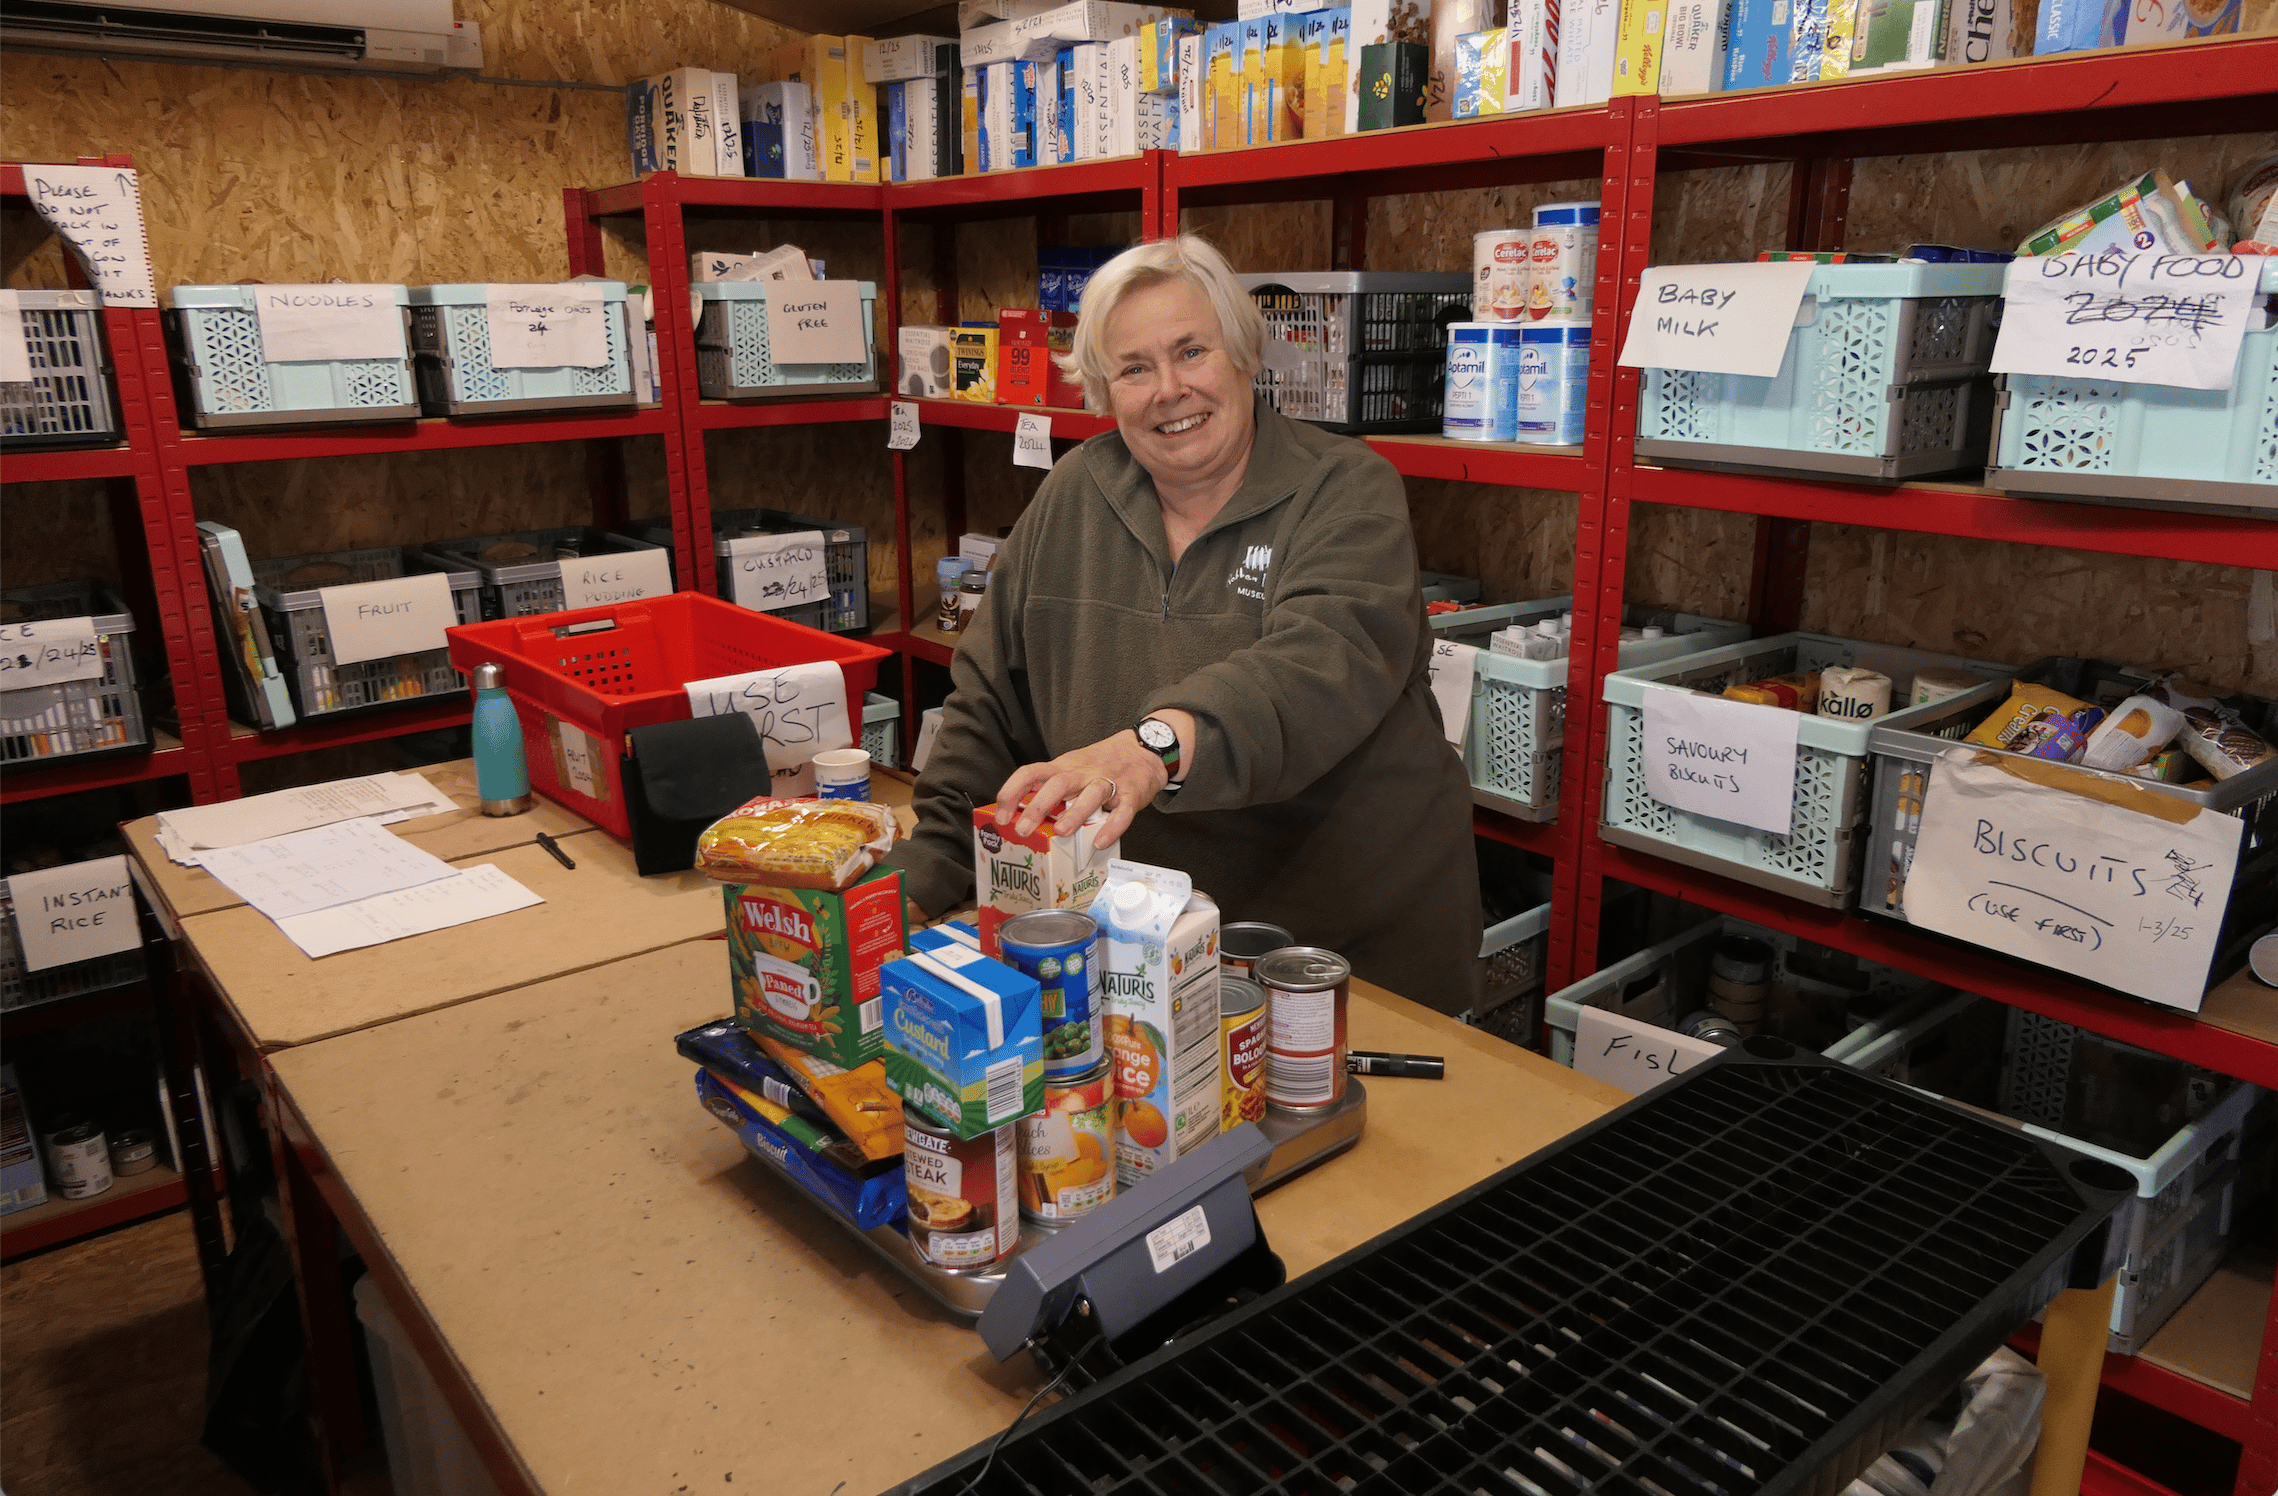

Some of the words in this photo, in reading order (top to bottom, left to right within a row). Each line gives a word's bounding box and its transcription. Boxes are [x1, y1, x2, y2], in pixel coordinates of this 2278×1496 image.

[1679, 6, 1688, 22] BIG
[1332, 17, 1349, 34] 1/26
[1688, 3, 1702, 51] QUAKER
[1721, 3, 1733, 52] QUAKER
[1966, 0, 1995, 63] Che
[879, 41, 900, 55] 12/25
[1567, 19, 1576, 65] WHEATS
[1574, 18, 1583, 62] MALTED
[1675, 23, 1686, 51] BOWL
[1638, 44, 1653, 86] Kellogg's
[639, 95, 649, 166] PORRIDGE
[662, 75, 677, 171] QUAKER
[721, 122, 738, 159] 12/25
[800, 121, 813, 151] 12/25
[854, 119, 864, 150] 12/25
[35, 178, 97, 200] PLEASE
[38, 203, 58, 215] DO
[70, 204, 109, 215] NOT
[53, 220, 90, 230] TACK
[103, 238, 120, 247] OF
[2137, 232, 2154, 250] 2
[93, 251, 126, 262] CON
[1494, 248, 1527, 258] Cerelac
[2042, 254, 2141, 289] BABY
[2150, 255, 2245, 281] FOOD
[270, 293, 374, 309] NOODLES
[783, 302, 827, 313] GLUTEN
[1657, 284, 1737, 310] BABY
[797, 319, 829, 331] FREE
[1657, 316, 1720, 338] MILK
[957, 361, 980, 370] Everyday
[1011, 348, 1031, 366] 99
[2066, 347, 2150, 368] 2025
[892, 403, 908, 417] TEA
[893, 421, 913, 432] 2025
[1020, 419, 1038, 431] TEA
[1019, 436, 1046, 450] 2024
[583, 570, 624, 584] RICE
[585, 588, 644, 602] PUDDING
[358, 601, 413, 620] FRUIT
[0, 623, 35, 641] CE
[1437, 644, 1458, 657] SE
[710, 669, 800, 717] USE
[760, 702, 836, 747] RST
[1996, 703, 2040, 745] Creams
[1667, 736, 1748, 764] SAVOURY
[1669, 764, 1741, 793] BISCUITS
[1974, 819, 2146, 896] BISCUITS
[991, 858, 1041, 901] NATURIS
[1072, 875, 1100, 896] NATURIS
[50, 911, 107, 934] RICE
[743, 901, 811, 943] Welsh
[2139, 916, 2194, 943] 1-3/25
[765, 973, 803, 999] Paned
[1100, 970, 1155, 1003] NATURIS
[894, 1008, 950, 1060] Custard
[1113, 1048, 1151, 1067] ange
[757, 1133, 788, 1162] Biscuit
